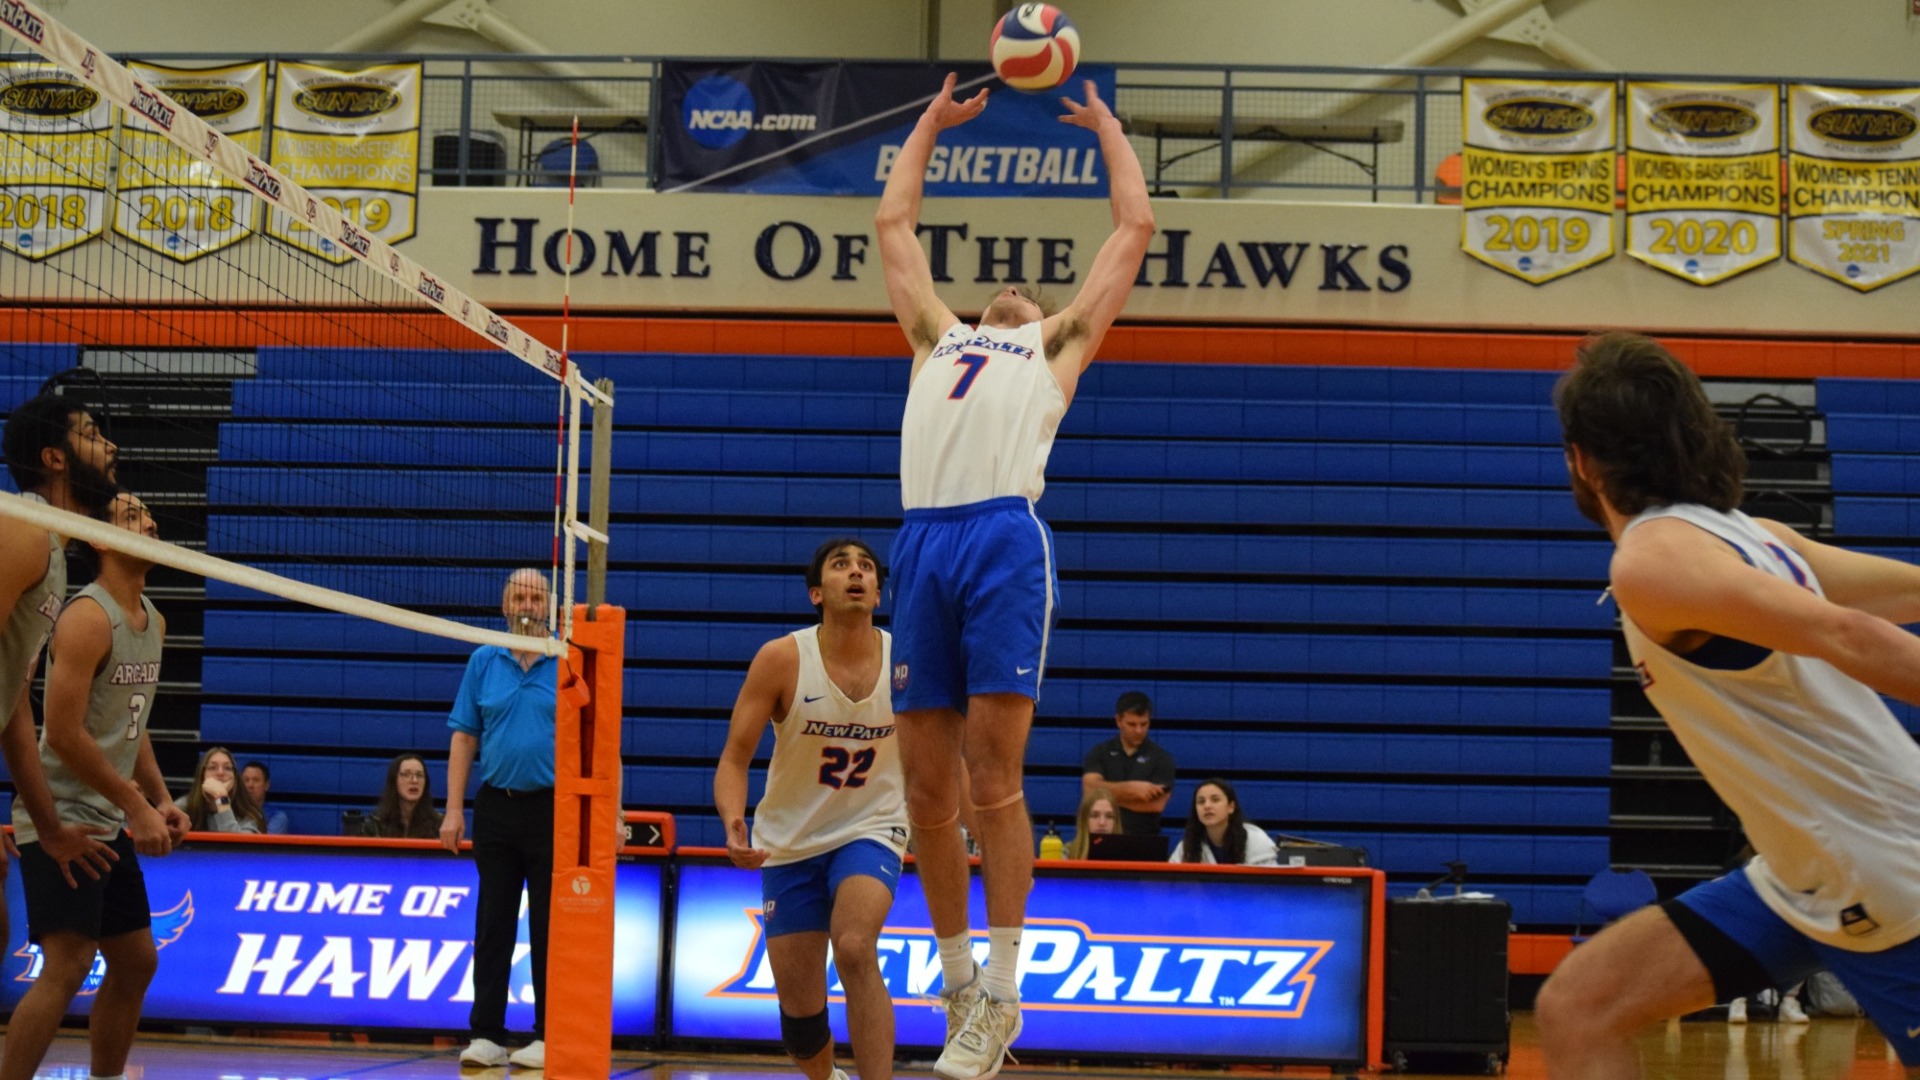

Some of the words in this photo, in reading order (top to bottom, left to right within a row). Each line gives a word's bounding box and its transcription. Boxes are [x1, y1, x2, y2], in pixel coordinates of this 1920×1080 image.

[2, 88, 93, 110] SUNYAC
[302, 91, 393, 112] SUNYAC
[689, 109, 817, 131] NCAA.com
[278, 136, 332, 159] WOMEN'S
[336, 137, 412, 160] BASKETBALL
[275, 162, 412, 183] CHAMPIONS
[874, 144, 1099, 184] BSKETBALL
[1468, 154, 1547, 179] WOMEN'S
[1551, 158, 1610, 180] TENNIS
[1633, 157, 1693, 180] WOMEN'S
[1695, 160, 1773, 181] BASKETBALL
[1794, 162, 1872, 186] WOMEN'S
[1465, 180, 1611, 204] CHAMPIONS
[1632, 183, 1776, 206] CHAMPIONS
[0, 193, 86, 230] 2018
[137, 194, 235, 232] 2018
[1484, 214, 1592, 254] 2019
[1648, 217, 1759, 256] 2020
[1822, 220, 1905, 242] SPRING
[472, 217, 711, 279] HOME
[754, 221, 869, 281] OF
[914, 222, 1076, 284] THE
[1133, 229, 1412, 293] HAWKS
[1838, 242, 1890, 263] 2021
[948, 353, 990, 400] 7
[126, 692, 147, 741] 3
[818, 745, 877, 792] 22
[235, 880, 393, 915] HOME
[400, 885, 470, 918] OF
[216, 932, 536, 1003] HAW
